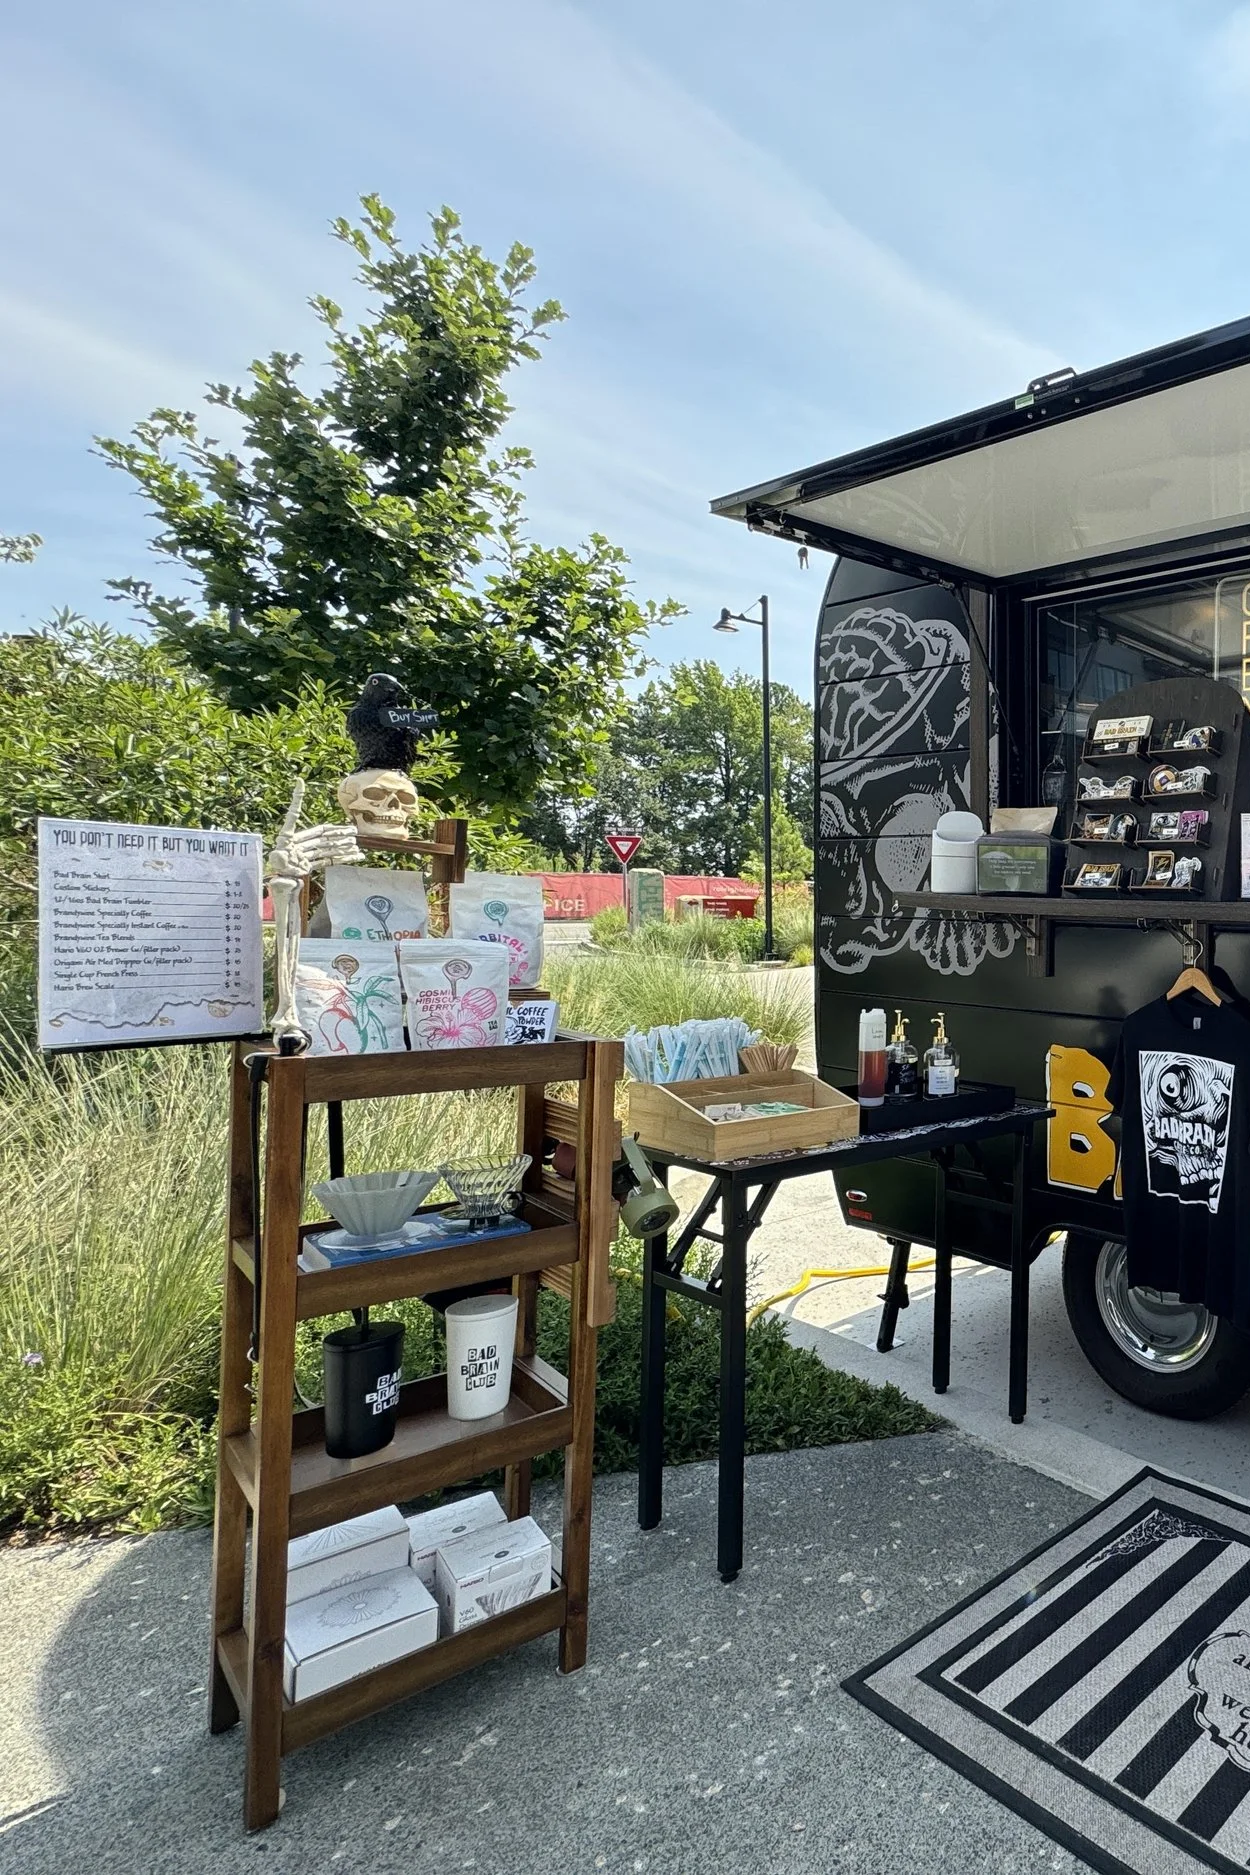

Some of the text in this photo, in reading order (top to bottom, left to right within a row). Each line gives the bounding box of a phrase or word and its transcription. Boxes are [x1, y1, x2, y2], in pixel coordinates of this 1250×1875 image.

[388, 710, 439, 723] BUY SHT
[53, 829, 249, 857] YOU DON'T NEED IT BUT YOU WANT IT
[53, 882, 111, 894] Custom Stickers
[123, 897, 152, 905] Tumbler
[544, 899, 585, 912] FICE
[131, 910, 152, 919] Coffee
[131, 921, 155, 929] Instant
[156, 921, 177, 931] Coffee
[96, 933, 135, 941] Tea Blends
[367, 927, 421, 941] ETHIOPIA
[53, 946, 75, 954] Hario
[106, 945, 129, 953] Brewer
[96, 968, 139, 978] French Press
[53, 983, 94, 991] Hario Brew
[415, 996, 461, 1006] HIBISCUS
[421, 1003, 456, 1012] BERRY
[517, 1006, 549, 1017] COFFEE
[517, 1016, 546, 1026] POWDER
[1154, 1116, 1179, 1140] BAD
[467, 1344, 497, 1362] BAD
[460, 1356, 501, 1377] BRAIN
[465, 1372, 497, 1392] CLUB
[460, 1577, 485, 1589] HARIO
